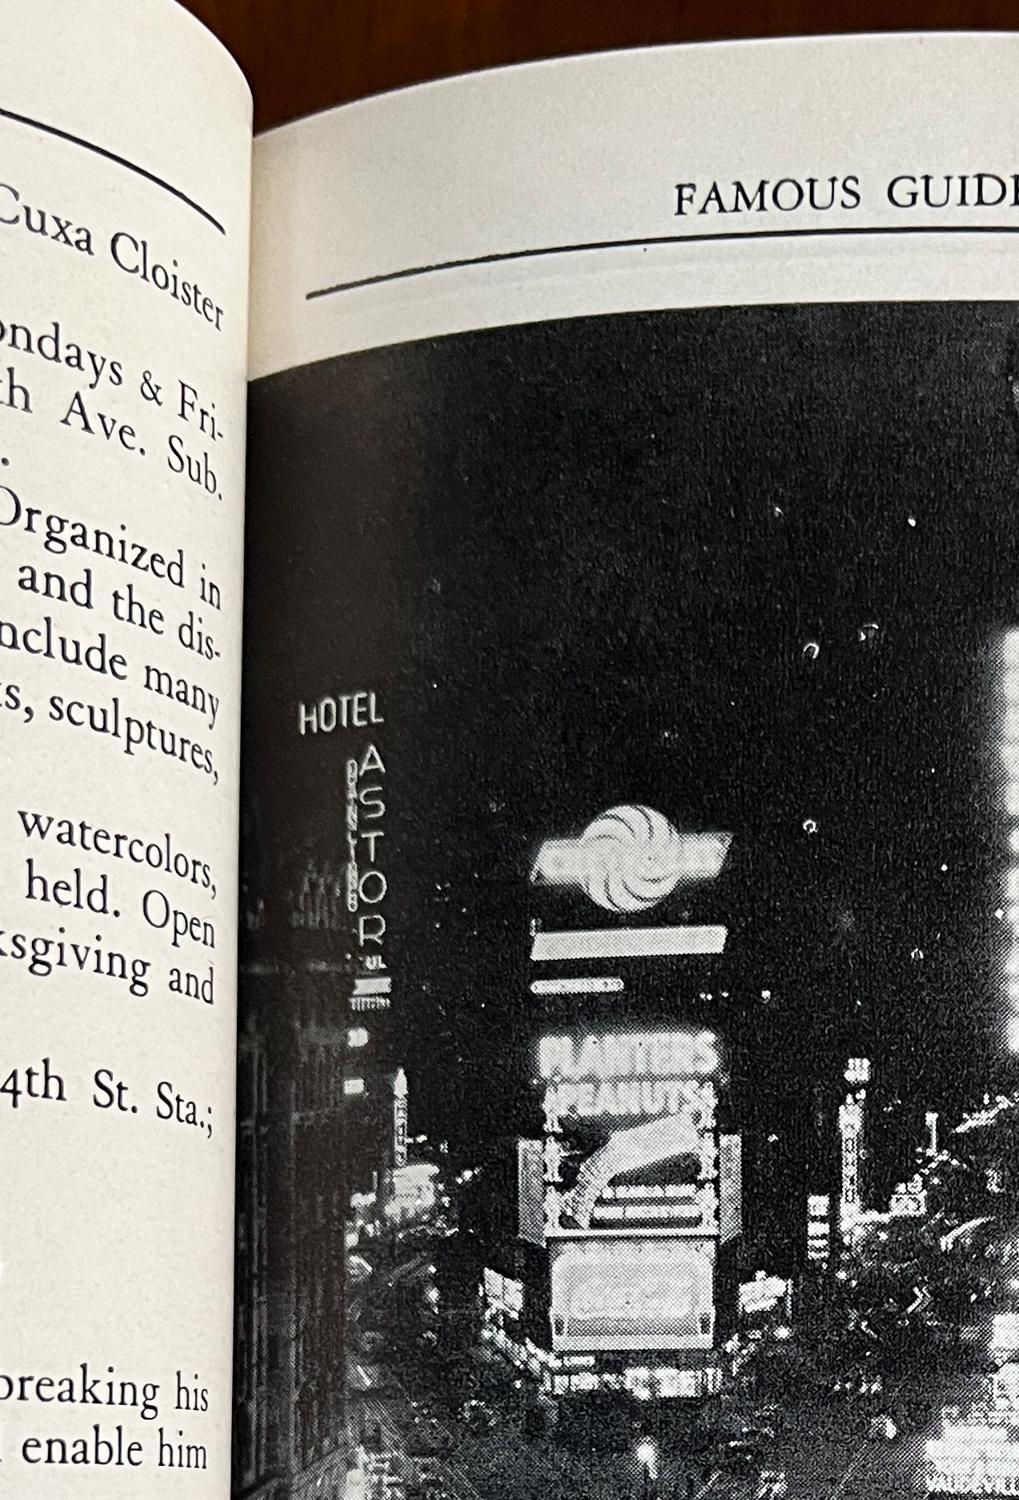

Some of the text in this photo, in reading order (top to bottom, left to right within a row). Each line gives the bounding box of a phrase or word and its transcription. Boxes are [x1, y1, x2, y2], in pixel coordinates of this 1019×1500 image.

[674, 176, 860, 216] FAMOUS
[111, 232, 223, 331] Cloister
[0, 367, 222, 500] h Ave. Sub.
[141, 370, 162, 406] &
[178, 380, 223, 441] Fri-
[18, 566, 220, 660] and the dis-
[200, 564, 220, 610] in
[0, 685, 218, 785] s, sculptures,
[144, 665, 219, 730] many
[17, 808, 217, 899] watercolors,
[299, 691, 384, 735] HOTEL
[357, 743, 388, 948] ASTOR
[26, 858, 216, 948] held. Open
[0, 927, 213, 1004] sgiving and
[0, 1058, 212, 1138] 4th St. Sta.;
[175, 1370, 208, 1411] his
[22, 1424, 206, 1469] enable him
